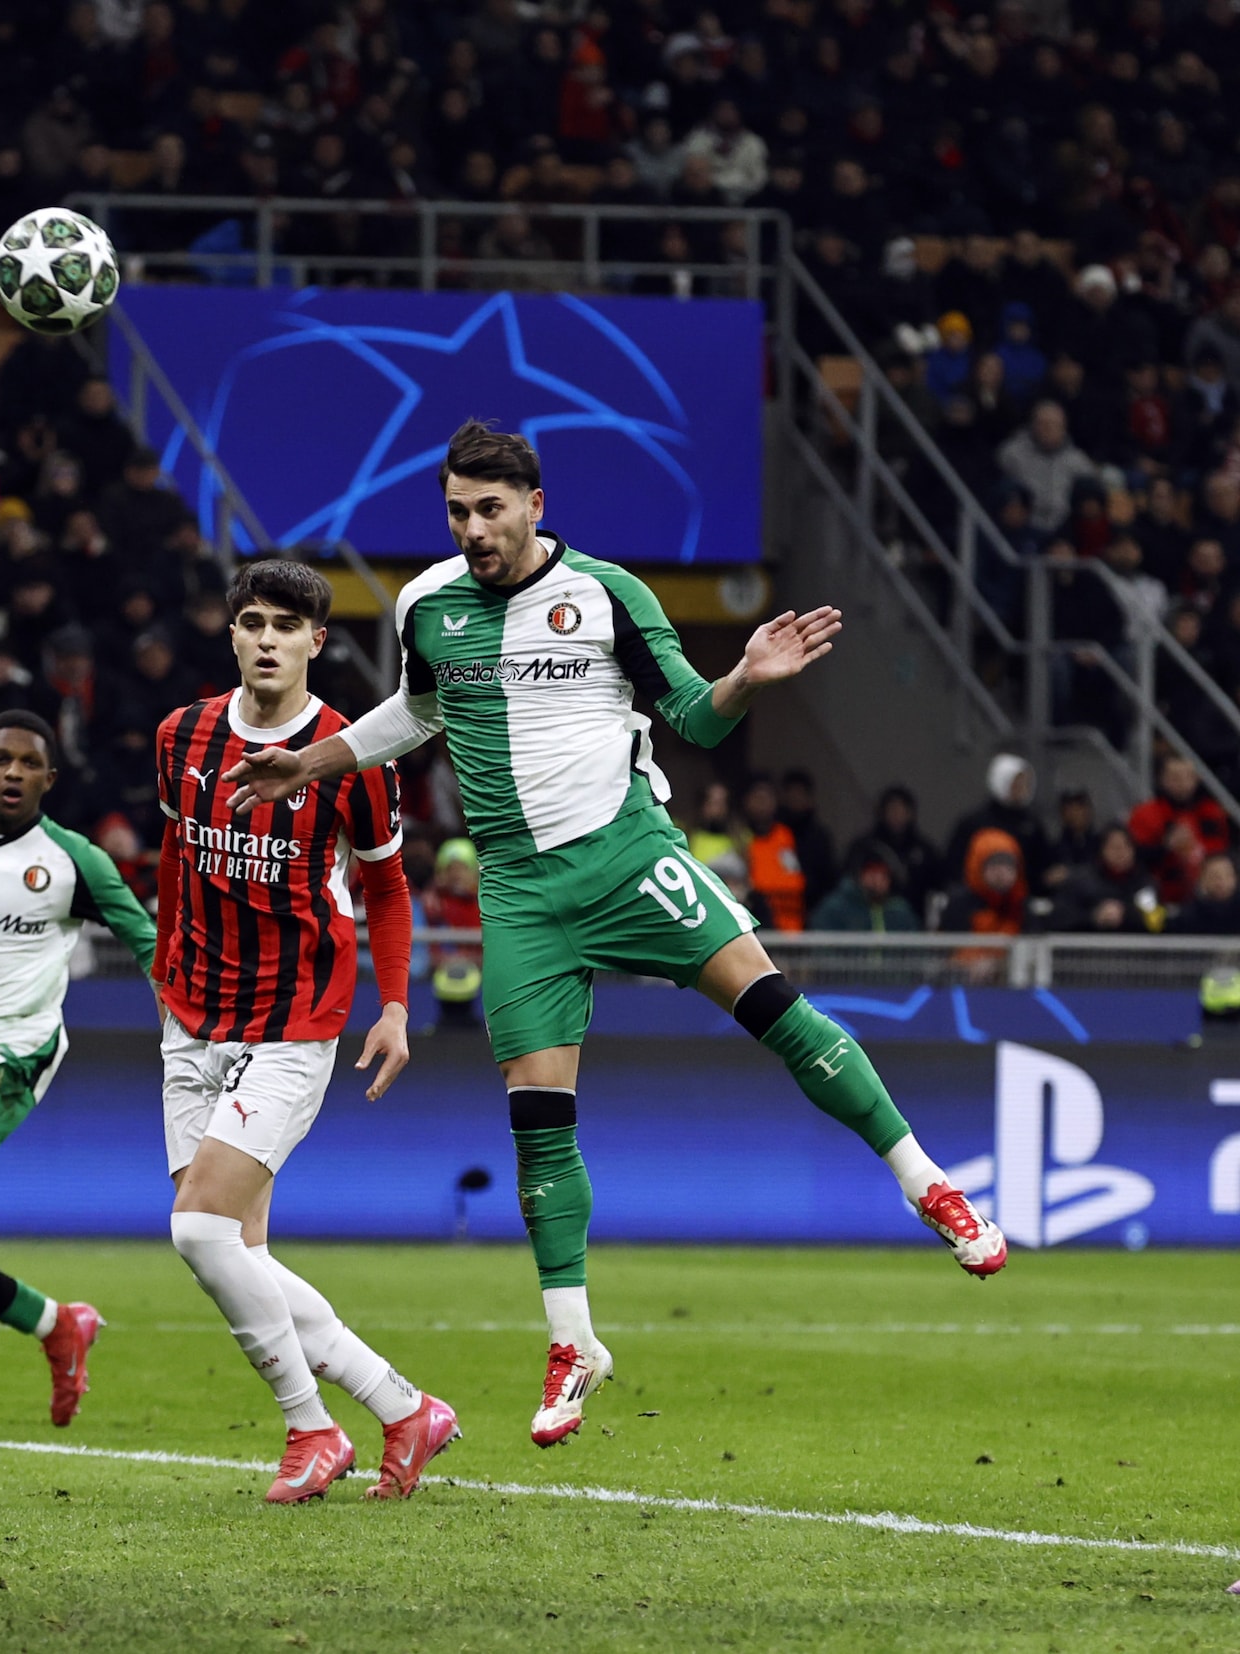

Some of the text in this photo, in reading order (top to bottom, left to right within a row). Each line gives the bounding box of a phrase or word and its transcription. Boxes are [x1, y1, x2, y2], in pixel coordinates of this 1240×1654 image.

[517, 657, 591, 682] Markt
[184, 816, 302, 860] Emirates
[197, 850, 282, 884] FLY BETTER
[637, 856, 698, 921] 19
